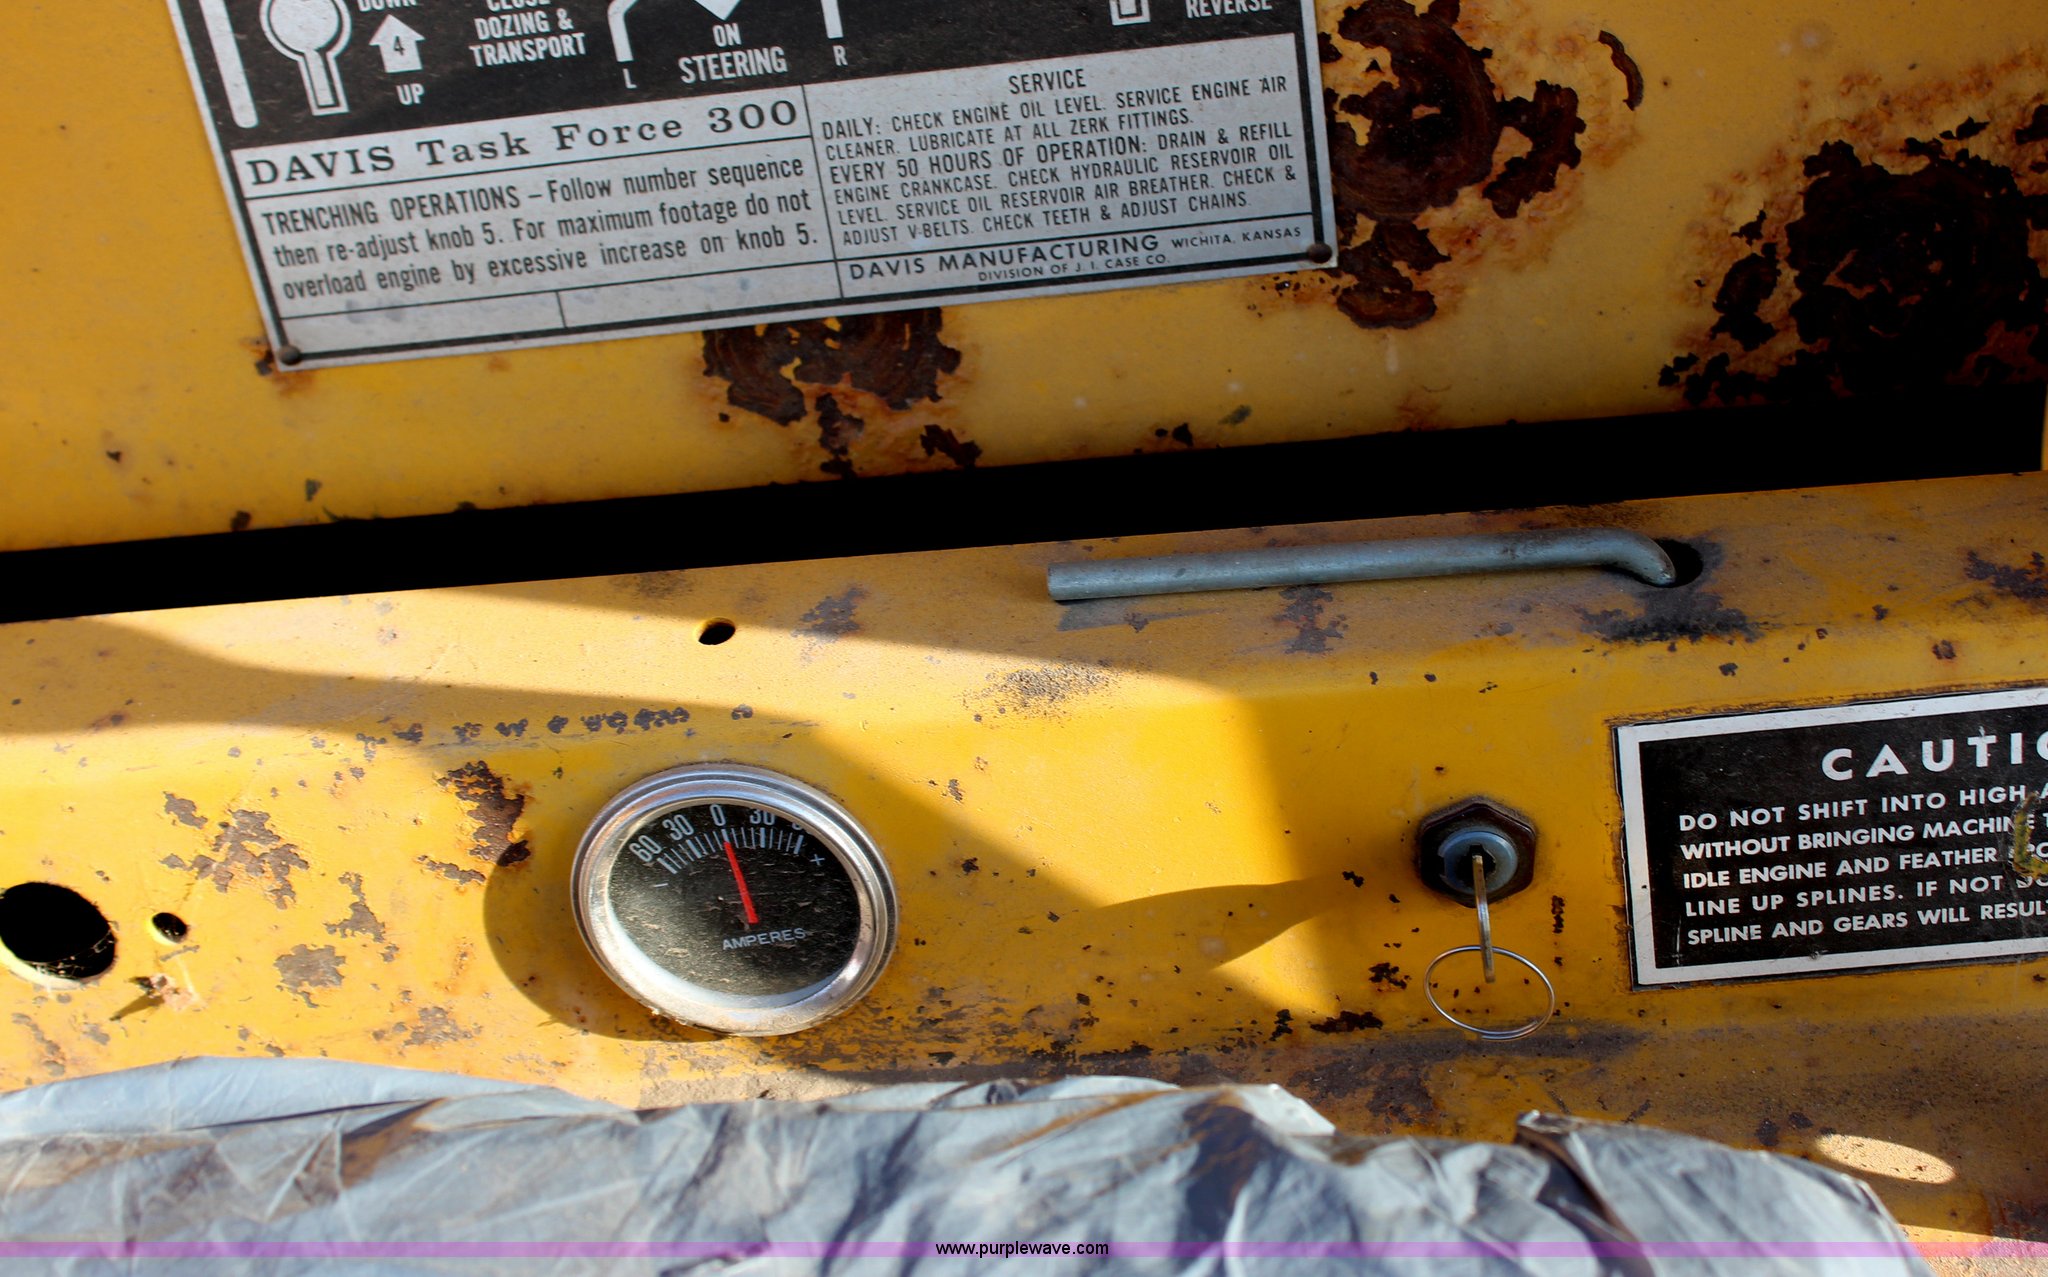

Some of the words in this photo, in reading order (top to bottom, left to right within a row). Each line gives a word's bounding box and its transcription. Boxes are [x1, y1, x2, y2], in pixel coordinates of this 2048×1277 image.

[393, 35, 405, 56] 4
[474, 10, 550, 40] DOZING
[556, 8, 574, 30] &
[712, 22, 742, 47] ON
[468, 32, 586, 67] TRANSPORT
[678, 46, 789, 84] STEERING
[832, 45, 848, 66] R
[396, 83, 425, 106] UP
[622, 68, 637, 89] L
[1008, 69, 1086, 95] SERVICE
[822, 117, 881, 140] DAILY:
[891, 112, 944, 132] CHECK
[953, 103, 1010, 126] ENGINE
[1021, 100, 1045, 118] OIL
[1055, 95, 1106, 115] LEVEL.
[1116, 87, 1181, 109] SERVICE
[1192, 79, 1251, 101] ENGINE
[1261, 75, 1288, 93] AIR
[246, 145, 396, 186] DAVIS
[416, 131, 530, 166] Task
[552, 119, 683, 150] Force
[708, 100, 797, 133] 300
[826, 139, 900, 161] CLEANER.
[909, 128, 995, 152] LUBRICATE
[1004, 125, 1022, 142] AT
[1033, 121, 1061, 140] ALL
[1070, 117, 1110, 136] ZERK
[1118, 108, 1194, 130] FITTINGS.
[830, 161, 885, 184] EVERY
[897, 158, 919, 178] 50
[928, 150, 992, 174] HOURS
[1002, 146, 1025, 167] OF
[1037, 135, 1147, 164] OPERATION:
[1158, 130, 1206, 150] DRAIN
[1217, 128, 1229, 145] &
[1239, 121, 1293, 142] REFILL
[834, 184, 891, 205] ENGINE
[901, 173, 998, 199] CRANKCASE.
[1008, 168, 1061, 187] CHECK
[1070, 157, 1160, 181] HYDRAULIC
[1171, 147, 1257, 171] RESERVOIR
[1268, 143, 1294, 161] OIL
[838, 207, 888, 226] LEVEL.
[897, 199, 961, 220] SERVICE
[967, 195, 993, 212] OIL
[1000, 187, 1085, 210] RESERVOIR
[1094, 183, 1120, 200] AIR
[1129, 173, 1215, 197] BREATHER.
[1223, 166, 1275, 188] CHECK
[1285, 165, 1297, 181] &
[262, 200, 379, 236] TRENCHING
[391, 185, 521, 222] OPERATIONS
[547, 177, 611, 203] Follow
[624, 168, 697, 195] number
[708, 158, 804, 187] sequence
[274, 245, 319, 268] then
[327, 230, 419, 262] re-adjust
[425, 225, 474, 245] knob
[481, 222, 504, 245] 5.
[513, 217, 545, 240] For
[558, 210, 653, 236] maximum
[659, 199, 737, 224] footage
[746, 193, 769, 216] do
[778, 189, 812, 213] not
[843, 226, 898, 246] ADJUST
[908, 219, 974, 240] V-BELTS.
[982, 213, 1035, 232] CHECK
[1042, 207, 1091, 227] TEETH
[1100, 204, 1112, 221] &
[1121, 198, 1178, 219] ADJUST
[283, 270, 366, 300] overload
[377, 264, 441, 291] engine
[451, 260, 475, 284] by
[488, 248, 587, 277] excessive
[599, 240, 687, 265] increase
[700, 235, 724, 254] on
[736, 225, 785, 250] knob
[796, 222, 818, 245] 5.
[850, 257, 926, 280] DAVIS
[939, 234, 1160, 272] MANUFACTURING
[1242, 226, 1302, 242] KANSAS
[978, 265, 1044, 282] DIVISION
[1050, 262, 1069, 274] OF
[1105, 256, 1140, 270] CASE
[1146, 253, 1170, 266] CO.
[1679, 813, 1717, 832] DO
[1729, 807, 1785, 827] NOT
[1798, 799, 1868, 821] SHIFT
[1881, 792, 1946, 813] INTO
[1959, 785, 2026, 806] HIGH
[629, 835, 662, 862] 60
[662, 814, 694, 841] 30
[709, 804, 726, 827] 0
[750, 808, 775, 826] 30
[1680, 836, 1790, 860] WITHOUT
[1798, 824, 1915, 850] BRINGING
[1683, 871, 1730, 889] IDLE
[1739, 862, 1827, 884] ENGINE
[1835, 857, 1890, 876] AND
[1899, 847, 1997, 870] FEATHER
[1685, 898, 1740, 917] LINE
[1752, 894, 1784, 911] UP
[1796, 884, 1904, 908] SPLINES.
[1917, 881, 1938, 897] IF
[1949, 875, 2003, 894] NOT
[722, 928, 806, 950] AMPERES
[1687, 924, 1762, 946] SPLINE
[1771, 919, 1824, 939] AND
[1833, 911, 1908, 933] GEARS
[1917, 907, 1970, 926] WILL
[1980, 899, 2048, 920] RESUL
